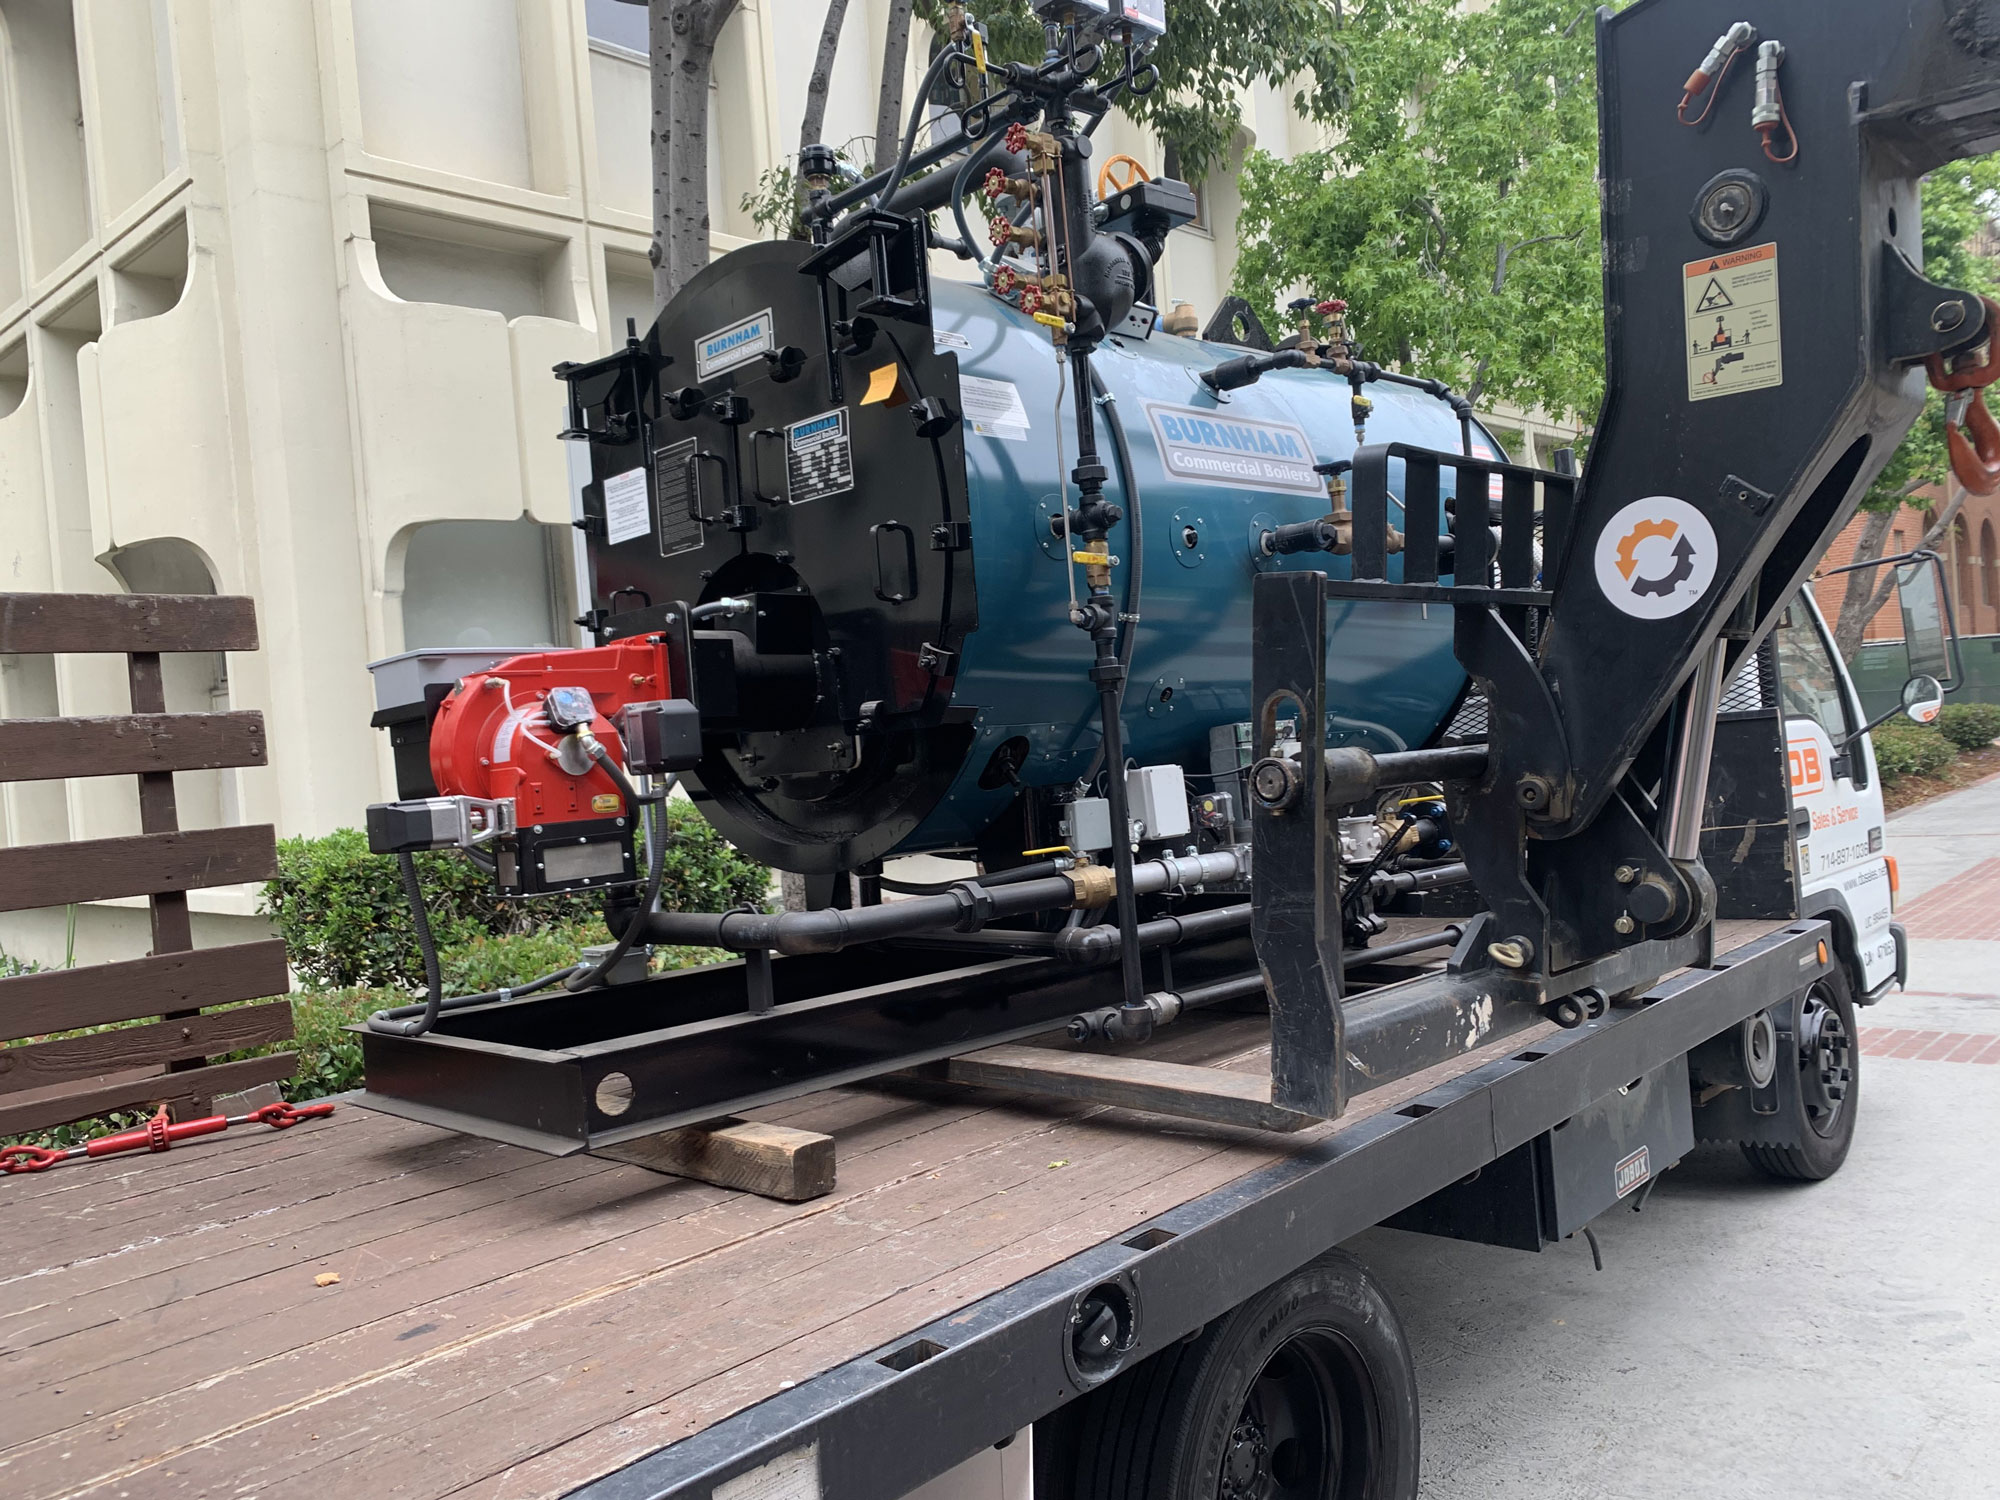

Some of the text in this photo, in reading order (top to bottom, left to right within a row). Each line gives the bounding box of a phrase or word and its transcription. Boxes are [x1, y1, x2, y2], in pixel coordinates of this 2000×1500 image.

[1722, 250, 1762, 266] WARNING
[706, 340, 764, 370] Commercial Boilers
[707, 324, 760, 356] BURNHAM
[793, 416, 837, 439] BURNHAM
[795, 433, 822, 448] Commercial
[1159, 414, 1303, 458] BURNHAM
[1173, 451, 1311, 482] Commercial Boilers
[1812, 805, 1859, 831] Sales & Service
[1618, 1154, 1647, 1189] JOBOX
